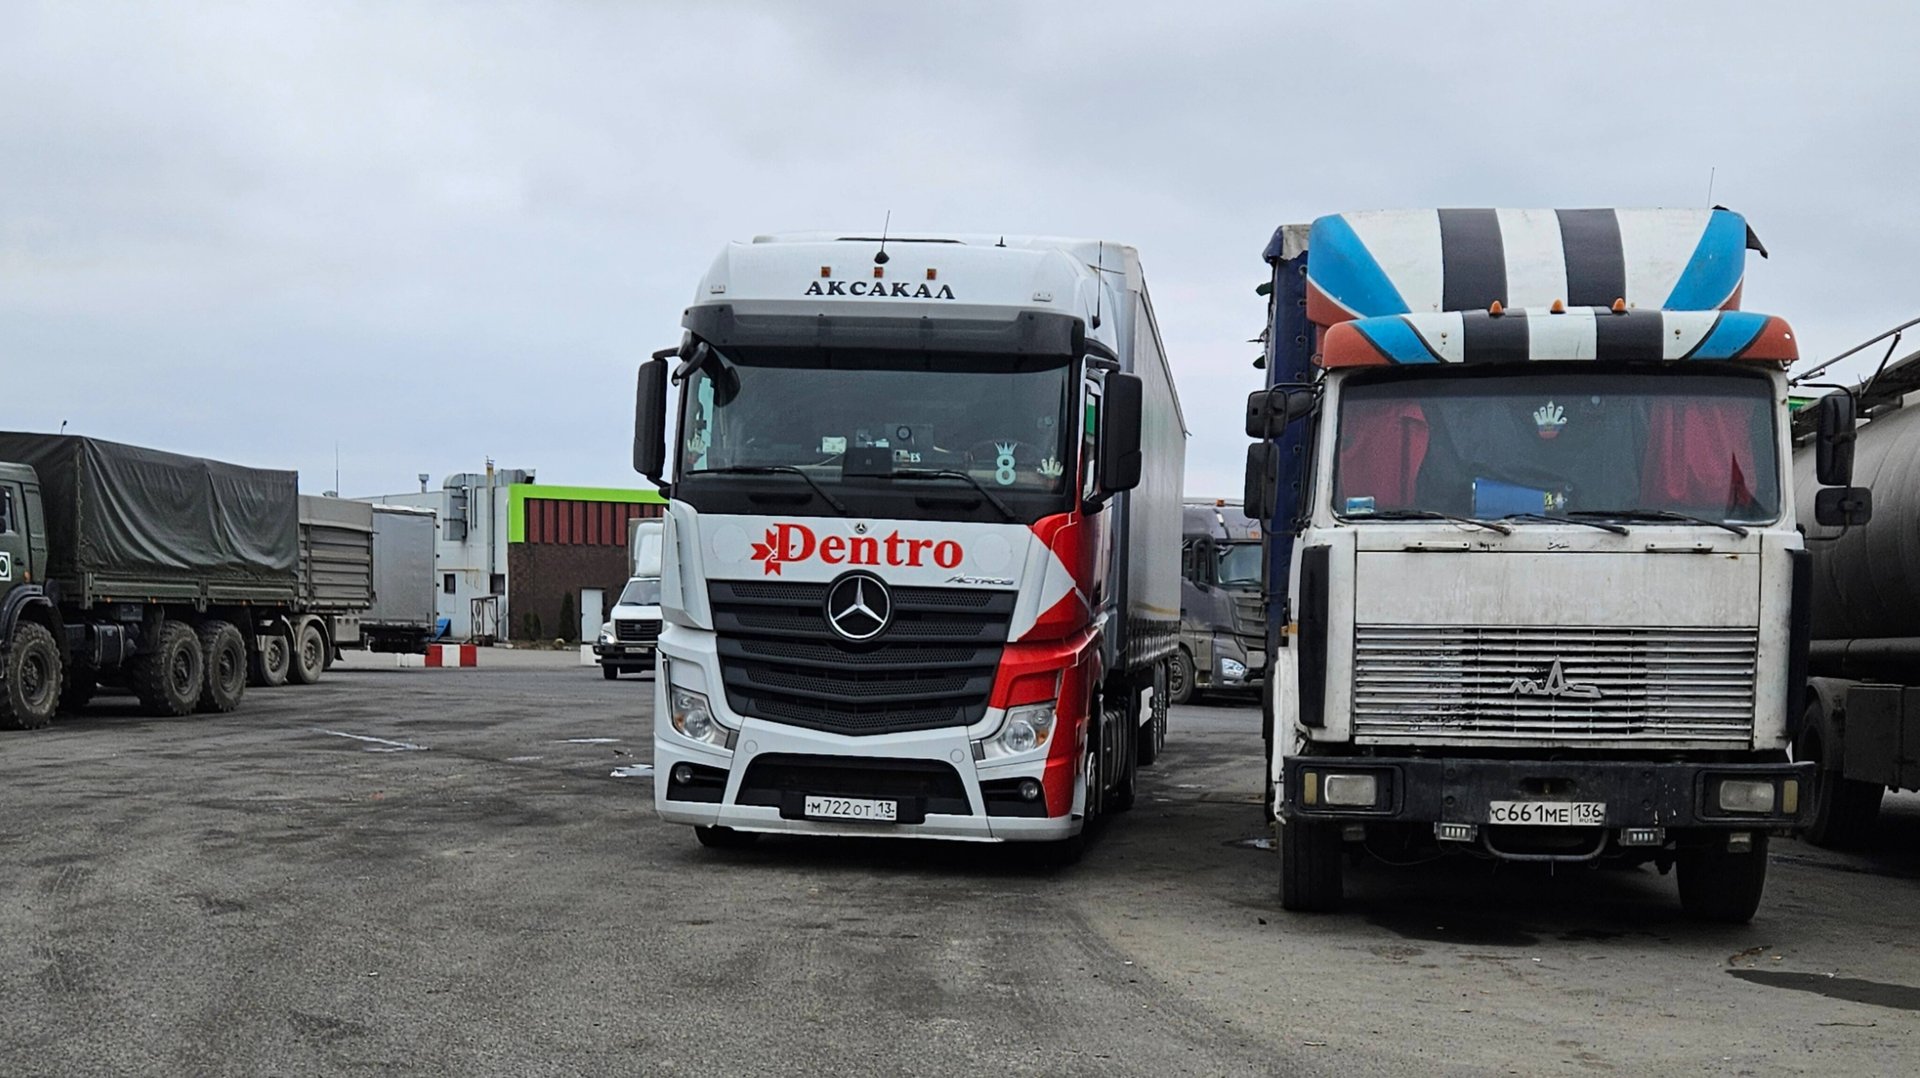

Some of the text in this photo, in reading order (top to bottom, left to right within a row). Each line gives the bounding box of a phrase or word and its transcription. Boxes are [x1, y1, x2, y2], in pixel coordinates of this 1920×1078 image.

[804, 281, 956, 299] АКСАКАЛ
[770, 523, 964, 568] Dentro
[1574, 804, 1601, 818] 136
